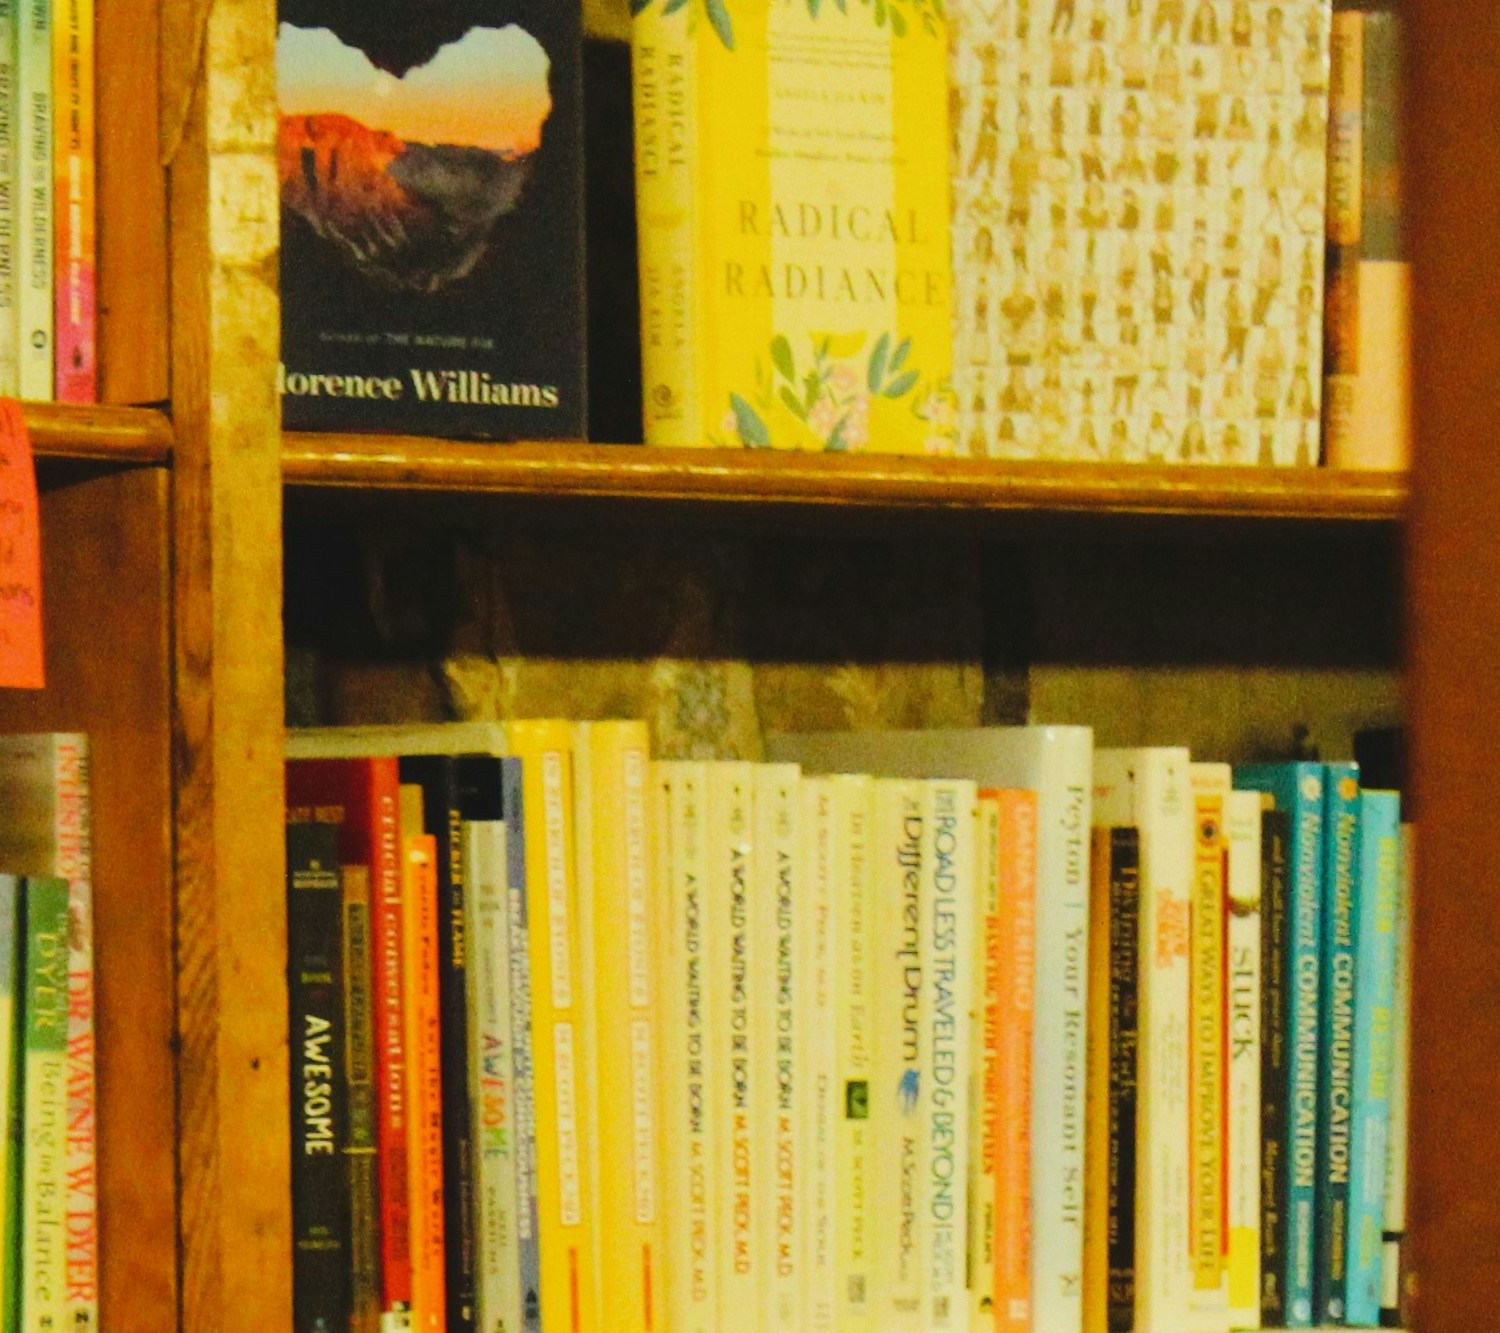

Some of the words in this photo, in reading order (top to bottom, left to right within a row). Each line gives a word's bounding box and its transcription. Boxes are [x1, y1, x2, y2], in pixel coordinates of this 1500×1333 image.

[739, 197, 929, 246] RADICAL
[722, 263, 941, 308] RADIANCE
[277, 364, 401, 401] lorence
[409, 370, 558, 408] Williams
[1334, 812, 1357, 945] Nonviolent
[304, 1014, 335, 1155] AWESOME
[1329, 954, 1352, 1183] COMMUNICATION
